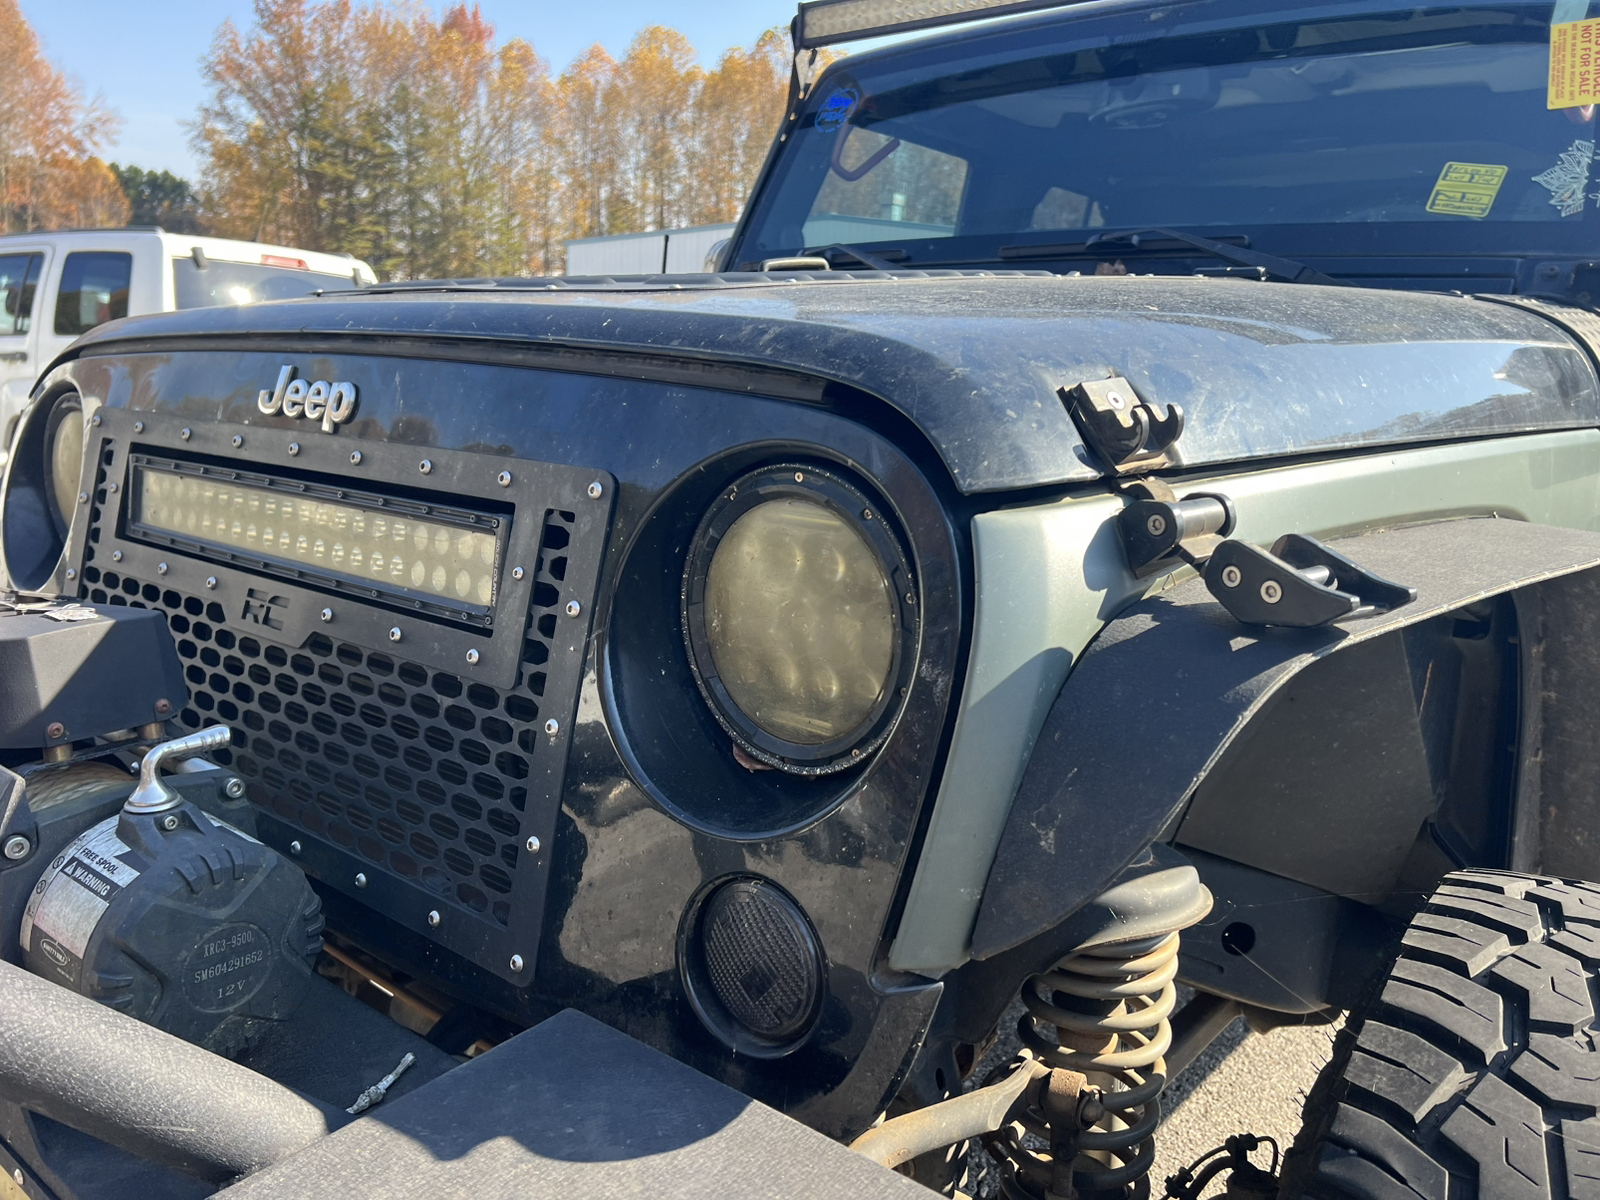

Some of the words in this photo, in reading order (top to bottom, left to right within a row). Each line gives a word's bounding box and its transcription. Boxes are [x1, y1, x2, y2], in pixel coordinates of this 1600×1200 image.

[1581, 25, 1592, 44] NOT
[1580, 47, 1591, 67] FOR
[1579, 70, 1590, 96] SALE
[257, 364, 357, 434] Jeep
[80, 847, 97, 863] FREE
[95, 856, 119, 875] SPOOL
[73, 866, 111, 897] WARNING
[203, 930, 252, 958] XRC3-9500
[194, 949, 263, 984] SM604291652
[217, 980, 246, 999] 12V
